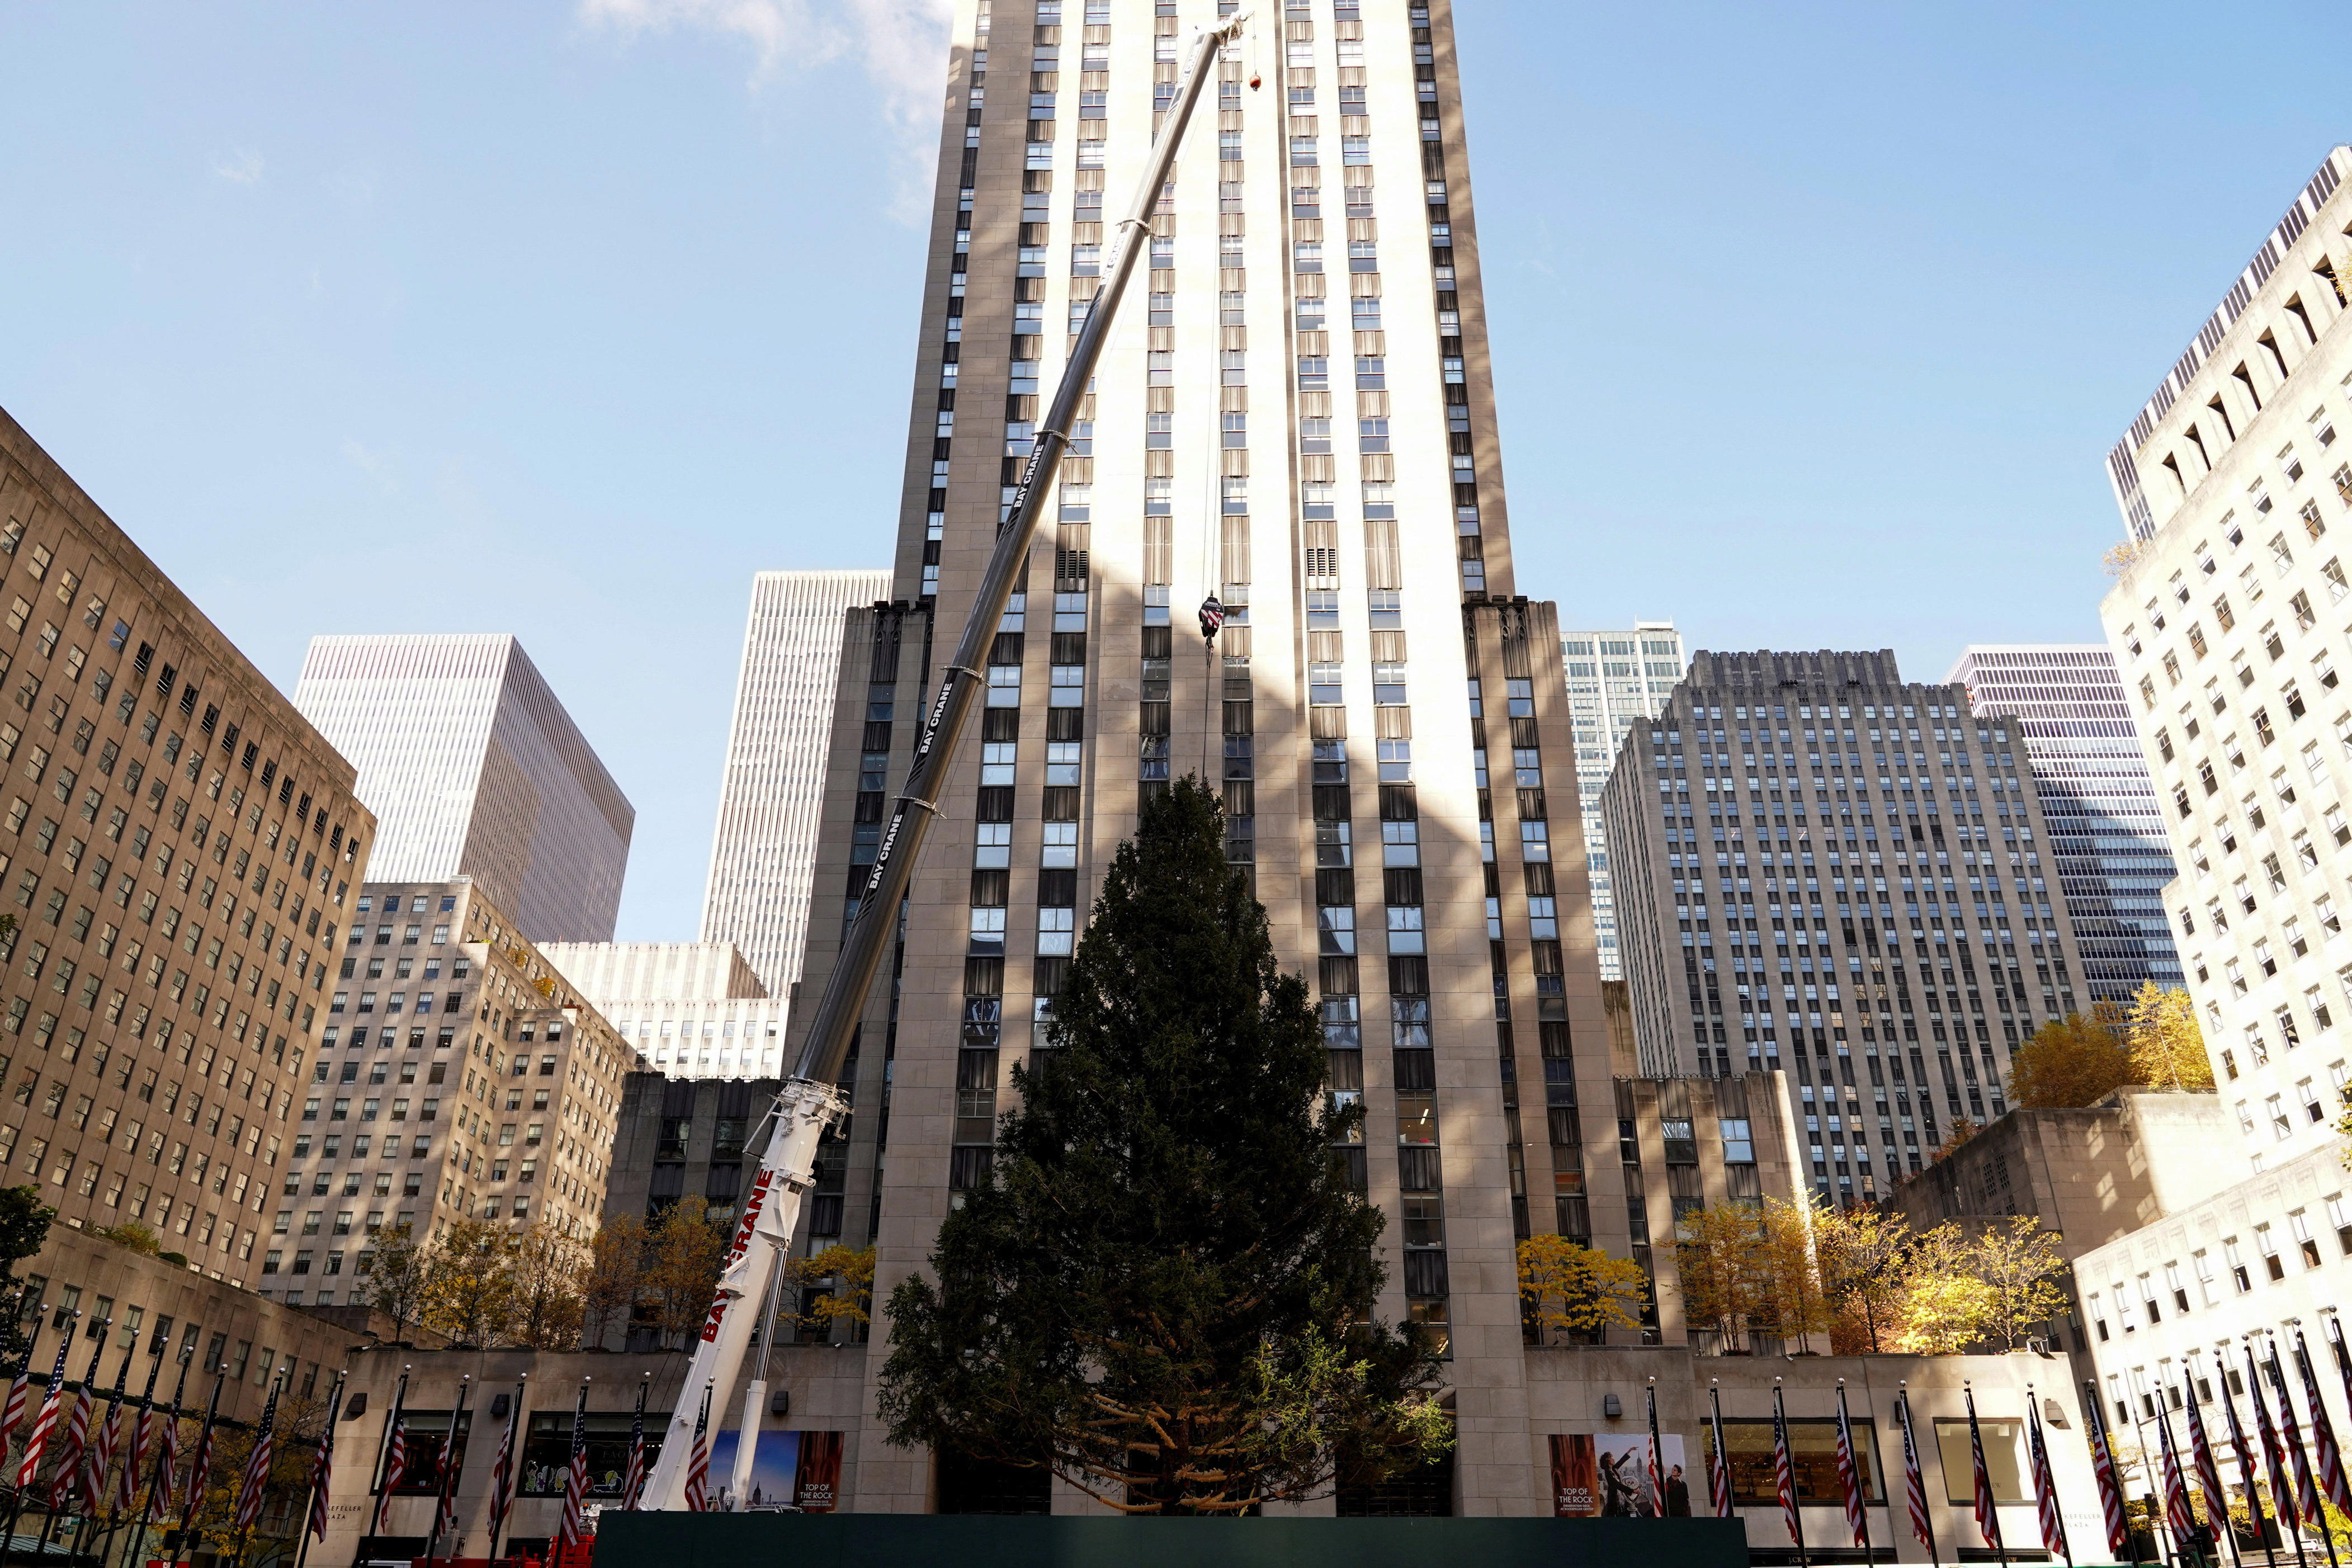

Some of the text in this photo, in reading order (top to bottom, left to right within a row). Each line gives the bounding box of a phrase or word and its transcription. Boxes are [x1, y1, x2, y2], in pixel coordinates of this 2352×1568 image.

[1014, 445, 1044, 508] BAY CRANE
[920, 683, 953, 754] BAY CRANE
[869, 814, 903, 889] BAY CRANE
[701, 1288, 730, 1343] BAY
[1788, 1556, 1811, 1565] J.CRW
